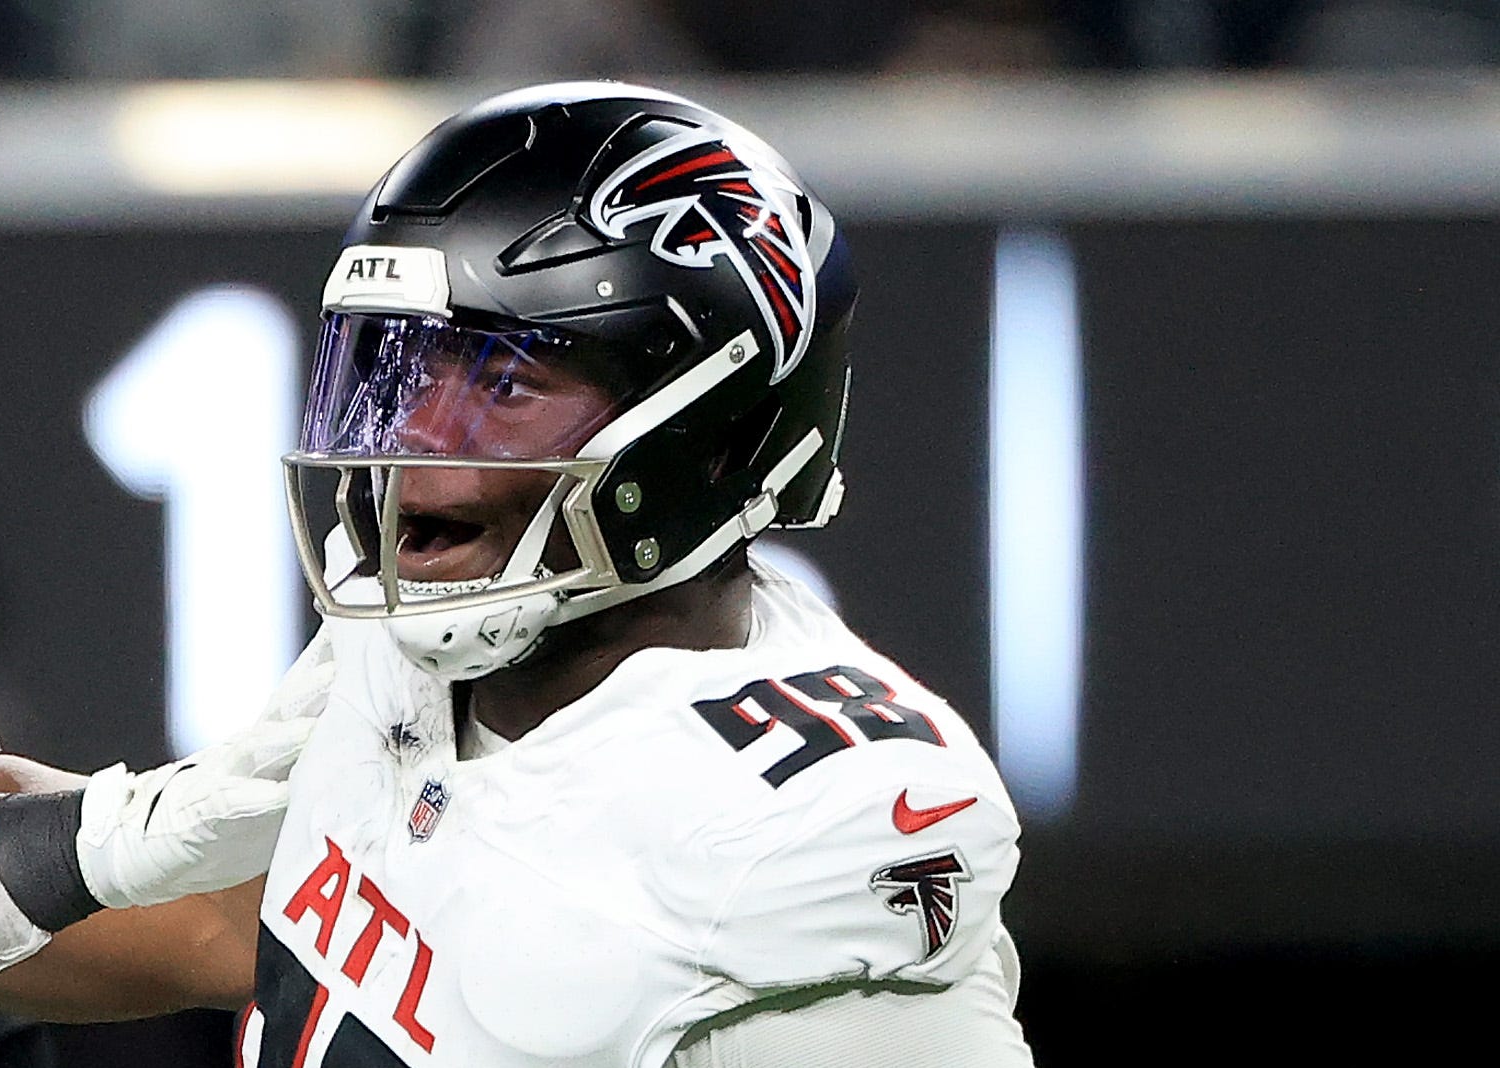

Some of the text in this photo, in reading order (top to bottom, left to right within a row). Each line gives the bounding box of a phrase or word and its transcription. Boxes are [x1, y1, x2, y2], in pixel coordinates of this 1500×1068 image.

[346, 257, 401, 281] ATL
[690, 664, 948, 790] 98
[411, 801, 436, 834] NFL
[283, 834, 436, 1055] ATL
